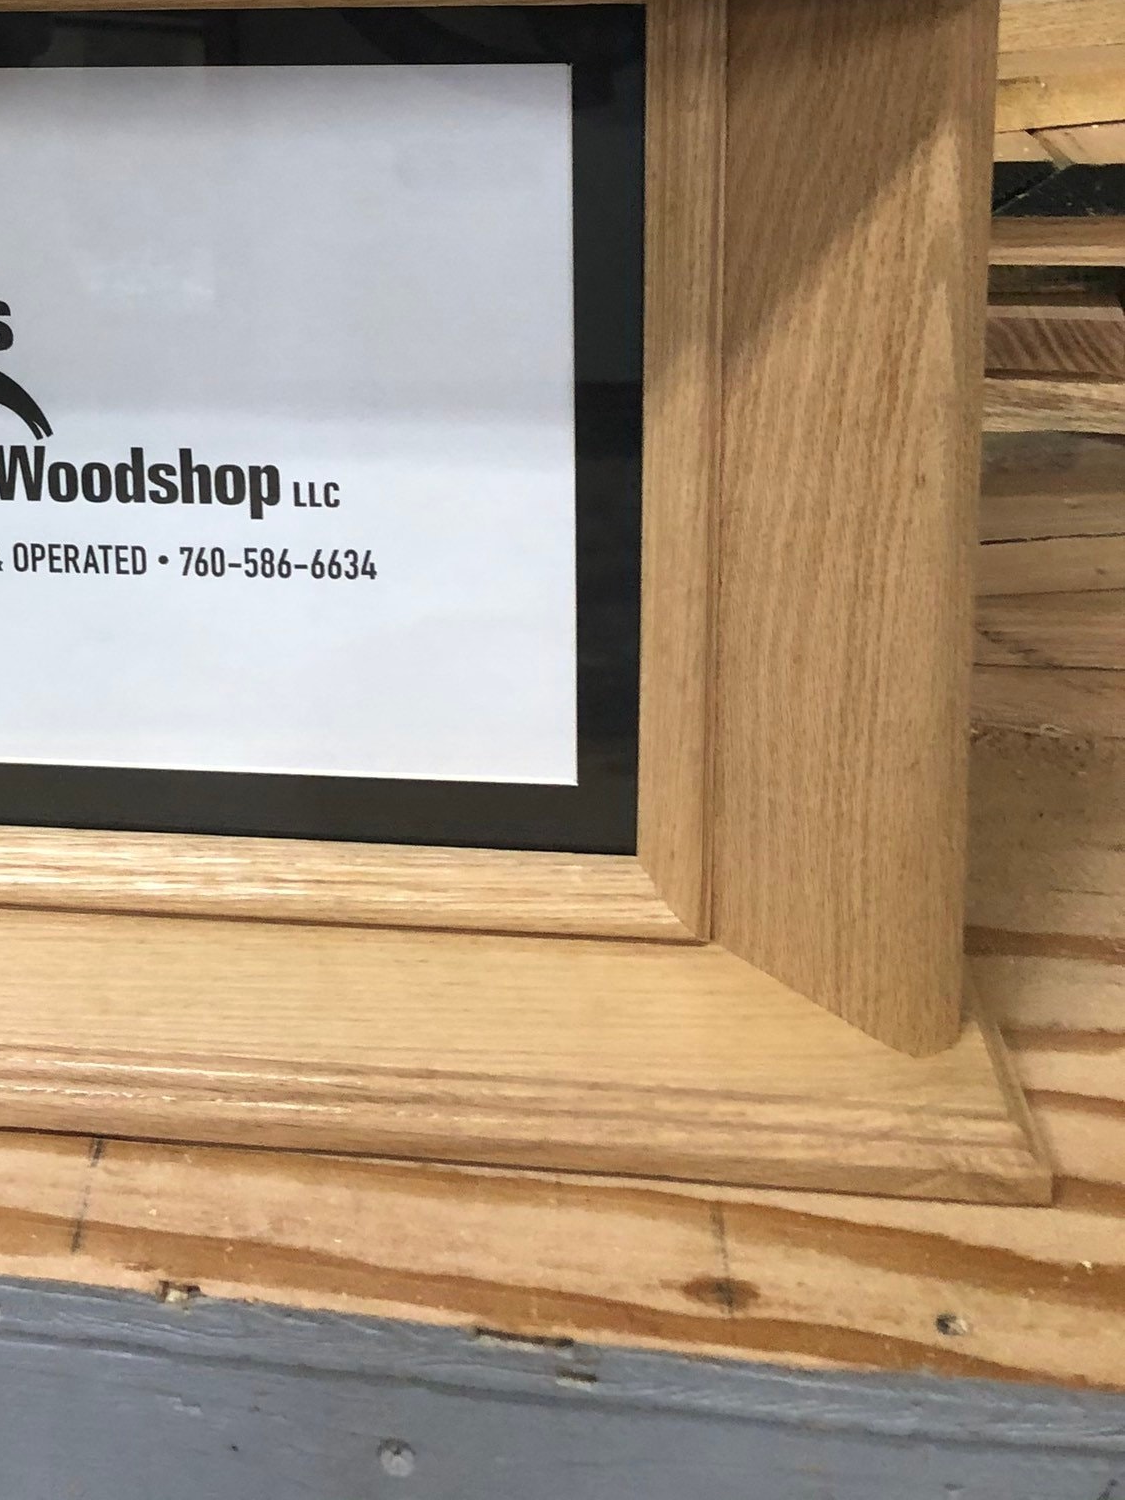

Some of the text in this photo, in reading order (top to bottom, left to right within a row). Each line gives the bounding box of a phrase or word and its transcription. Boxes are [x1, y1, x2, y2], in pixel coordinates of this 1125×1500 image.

[294, 481, 340, 508] LLC
[13, 543, 147, 575] OPERATED
[179, 546, 377, 580] 760-586-6634
